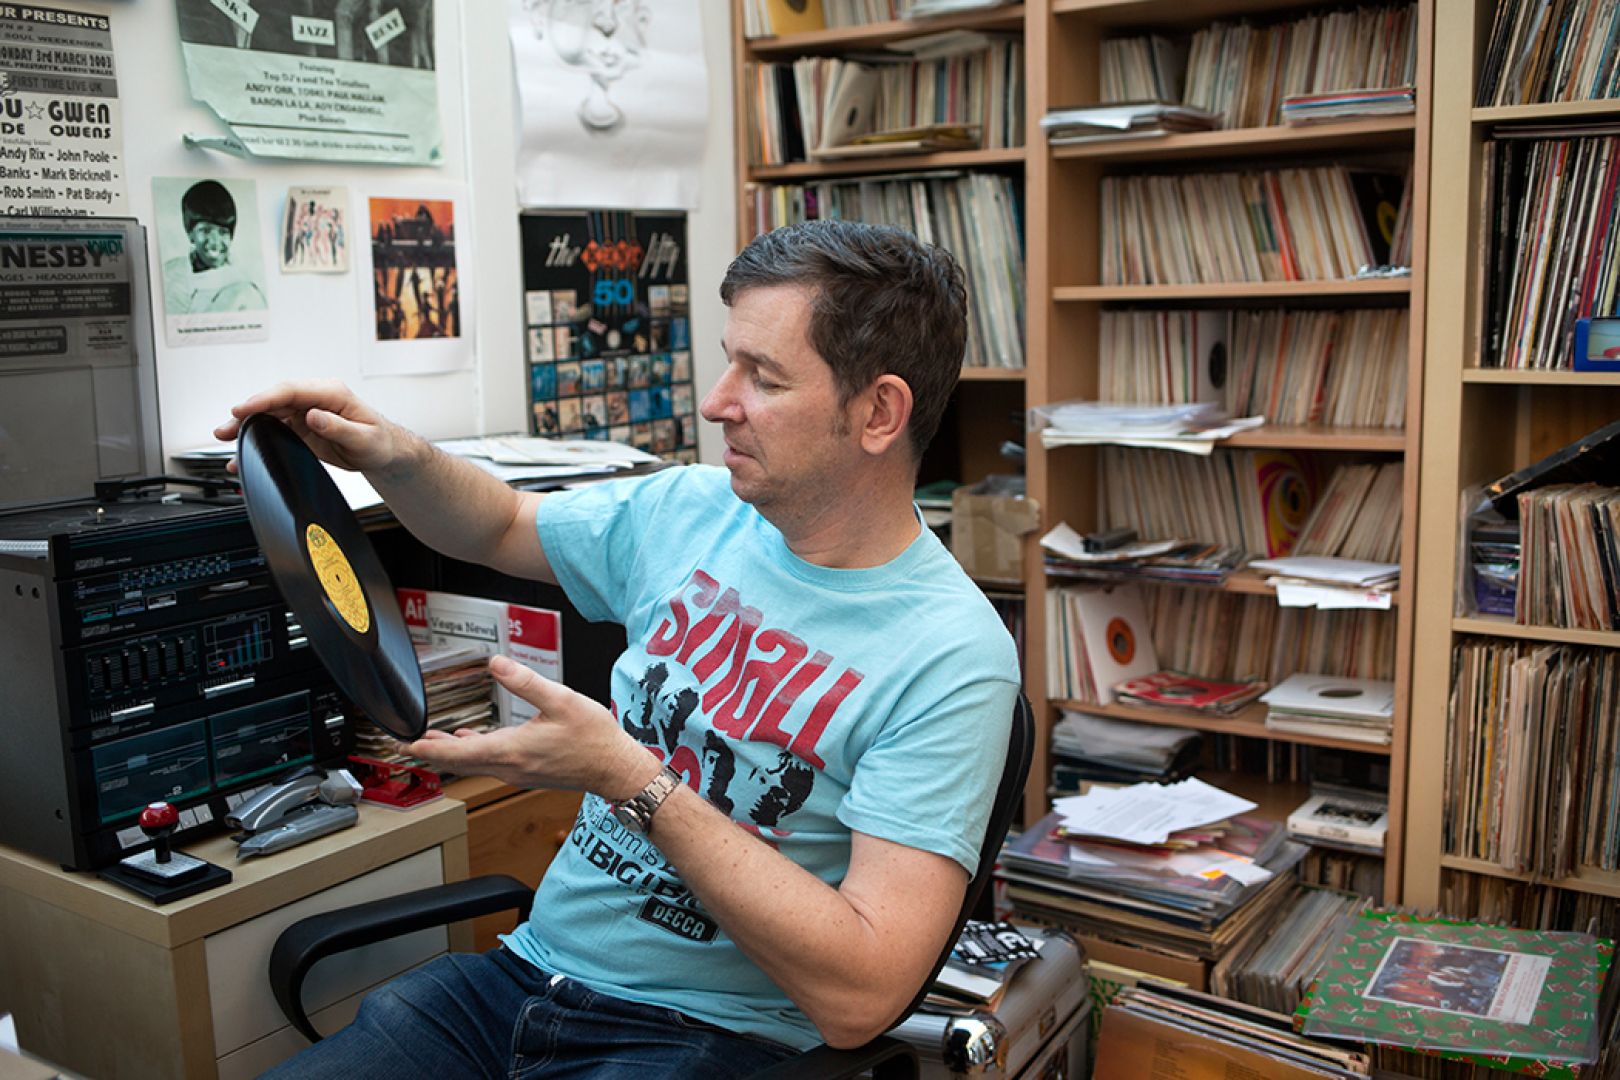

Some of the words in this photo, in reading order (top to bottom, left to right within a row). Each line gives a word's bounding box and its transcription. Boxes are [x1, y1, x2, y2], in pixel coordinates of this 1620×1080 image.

[22, 8, 108, 29] PRESENTS
[299, 24, 329, 38] JAZZ
[5, 33, 34, 41] SOUL
[38, 36, 104, 48] WEEKENDER
[54, 51, 87, 66] MARCH
[41, 78, 65, 90] TIME
[66, 80, 87, 92] LIVE
[88, 81, 103, 93] UK
[245, 82, 271, 94] ANDY
[250, 97, 284, 107] BARON
[48, 100, 110, 124] GWEN
[1, 122, 25, 134] DE
[50, 125, 111, 139] OWENS
[0, 147, 26, 163] Andy
[29, 148, 46, 160] Rix
[57, 150, 81, 162] John
[83, 151, 109, 163] Poole
[0, 167, 31, 179] Banks
[41, 168, 67, 180] Mark
[69, 168, 111, 182] Bricknell
[4, 186, 24, 198] Rob
[26, 187, 55, 199] Smith
[66, 188, 82, 200] Pat
[84, 189, 112, 204] Brady
[8, 205, 28, 216] Carl
[2, 244, 105, 268] NESBY
[545, 233, 581, 268] the
[36, 272, 116, 281] HEADQUARTERS
[594, 278, 635, 305] 50
[430, 616, 463, 634] Vespa
[591, 812, 643, 855] bum
[652, 904, 706, 939] DECCA
